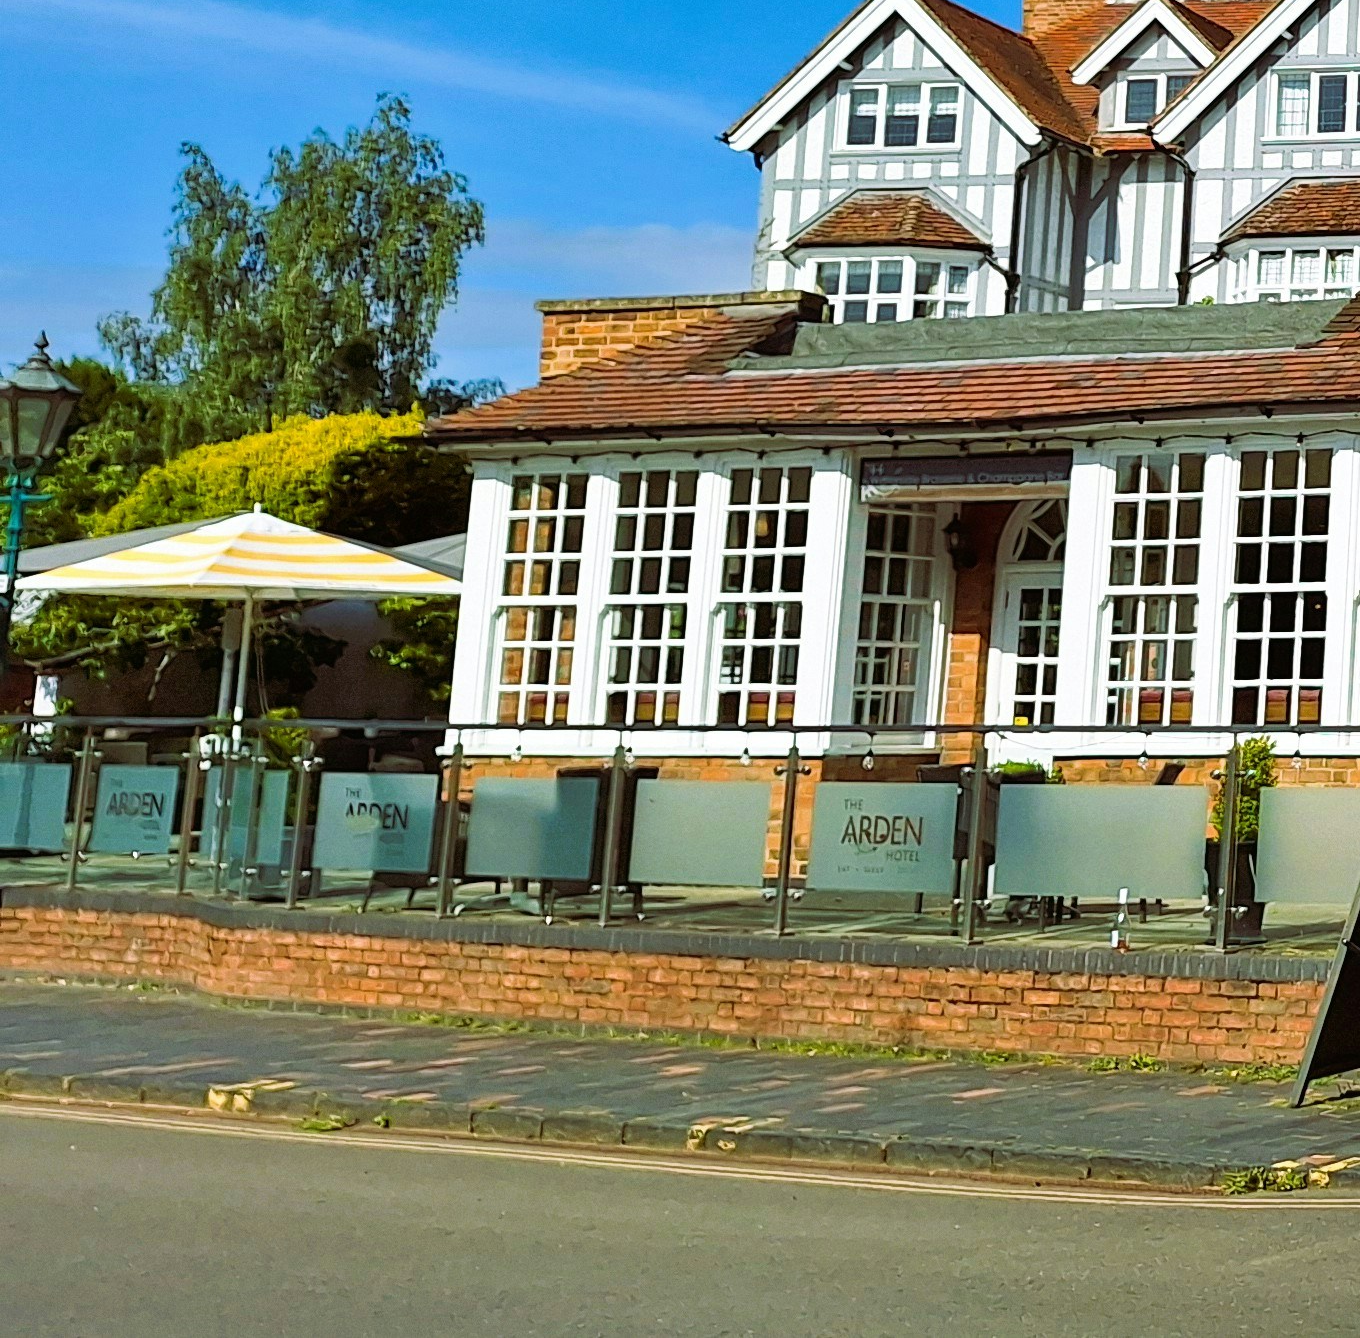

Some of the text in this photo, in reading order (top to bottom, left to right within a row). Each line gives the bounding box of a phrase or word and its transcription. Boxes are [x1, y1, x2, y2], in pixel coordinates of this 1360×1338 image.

[844, 799, 863, 810] THE
[841, 815, 924, 846] ARDEN
[886, 850, 920, 862] HOTEL
